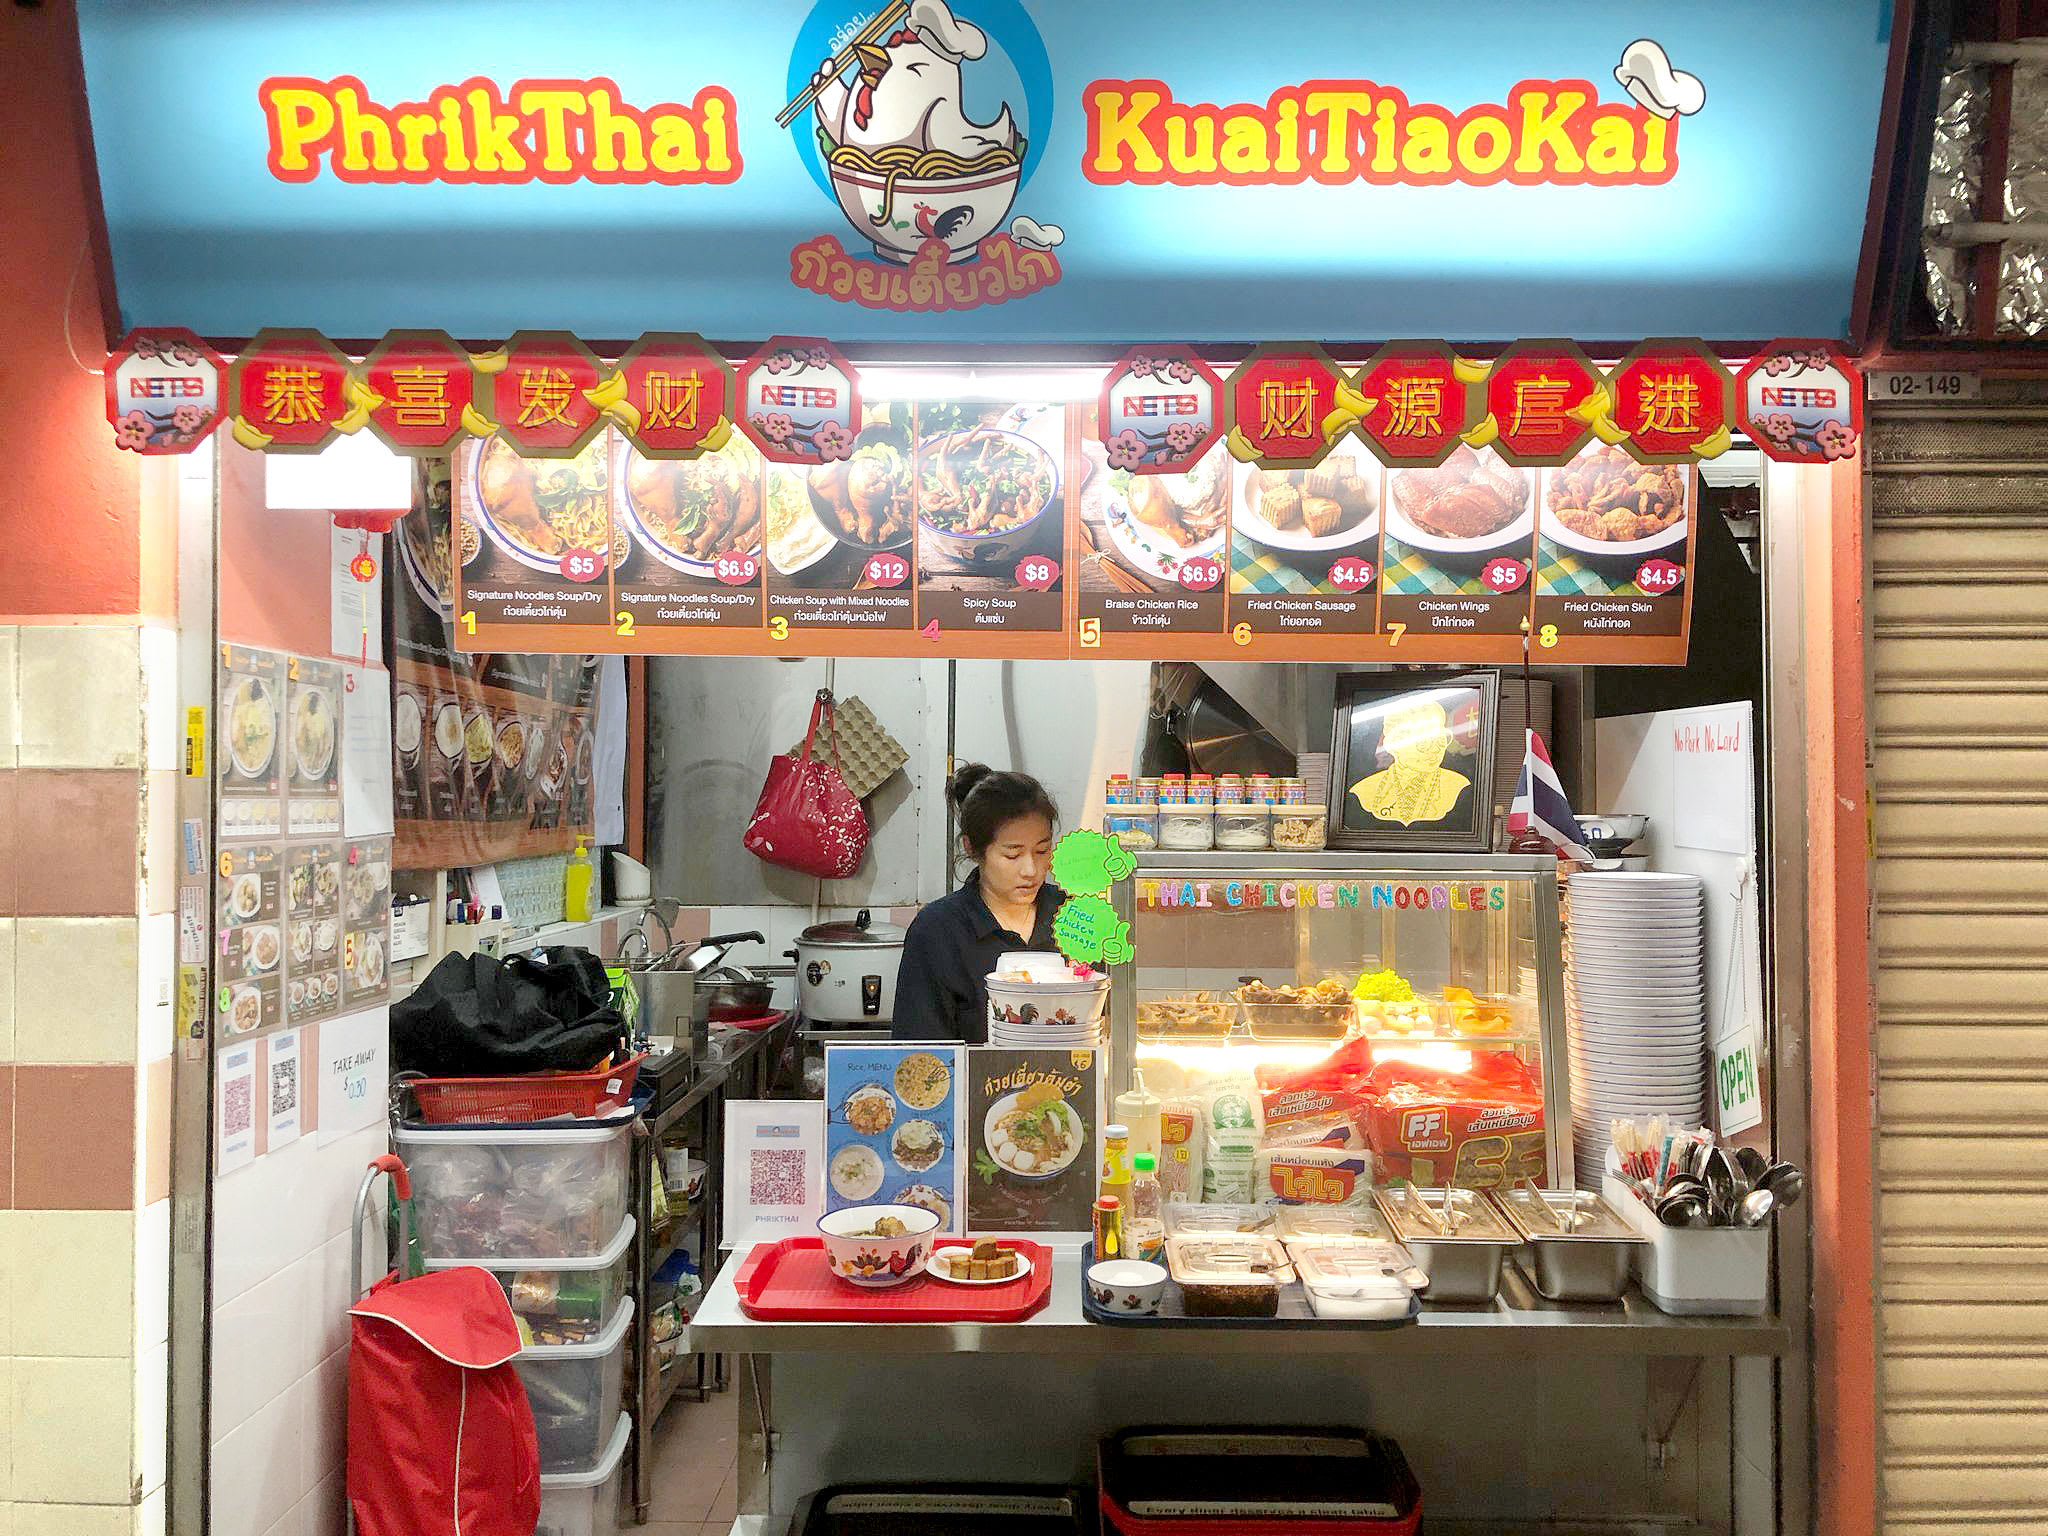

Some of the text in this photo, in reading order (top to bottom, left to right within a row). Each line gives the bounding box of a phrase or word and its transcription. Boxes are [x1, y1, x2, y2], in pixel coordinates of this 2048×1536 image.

[268, 84, 735, 175] PhrikThai
[1091, 90, 1673, 175] KuaiTiaoKai
[130, 377, 204, 398] NETS
[1889, 375, 1961, 395] 02-149
[761, 384, 837, 409] NETS
[1123, 394, 1199, 417] NETS
[1761, 387, 1837, 409] NETS
[569, 557, 595, 575] $5
[718, 559, 755, 577] $6.9
[869, 562, 904, 580] $12
[1024, 563, 1049, 582] $8
[1181, 566, 1219, 584] $6.9
[1333, 566, 1370, 585] $4.5
[1491, 566, 1517, 585] $5
[1640, 567, 1678, 586] $4.5
[467, 589, 602, 604] Signature Noodles Soup/Dry
[620, 592, 756, 607] Signature Noodles Soup/Dry
[769, 594, 909, 608] Chicken Soup with Mixed Noodles
[963, 597, 1017, 610] Spicy Soup
[1105, 599, 1199, 610] Braise Chicken Rice
[1247, 600, 1356, 613] Fried Chicken Sausage
[1418, 601, 1490, 613] Chicken Wings
[1563, 602, 1653, 613] Fried Chicken Skin
[460, 611, 477, 635] 1
[615, 612, 636, 636] 2
[770, 616, 790, 641] 3
[922, 618, 940, 643] 4
[1082, 619, 1099, 645] 5
[1232, 622, 1252, 646] 6
[1386, 623, 1407, 647] 7
[1539, 624, 1559, 648] 8
[1674, 720, 1740, 752] No Pork No Lard
[219, 852, 233, 878] 6
[1140, 882, 1505, 912] THAI CHICKEN NOODLES
[1067, 904, 1095, 924] Fried
[332, 1048, 376, 1075] TAKE AWAY
[1719, 1045, 1755, 1111] OPEN
[1407, 1112, 1442, 1138] FF
[755, 1215, 800, 1223] PHRIKTHAI
